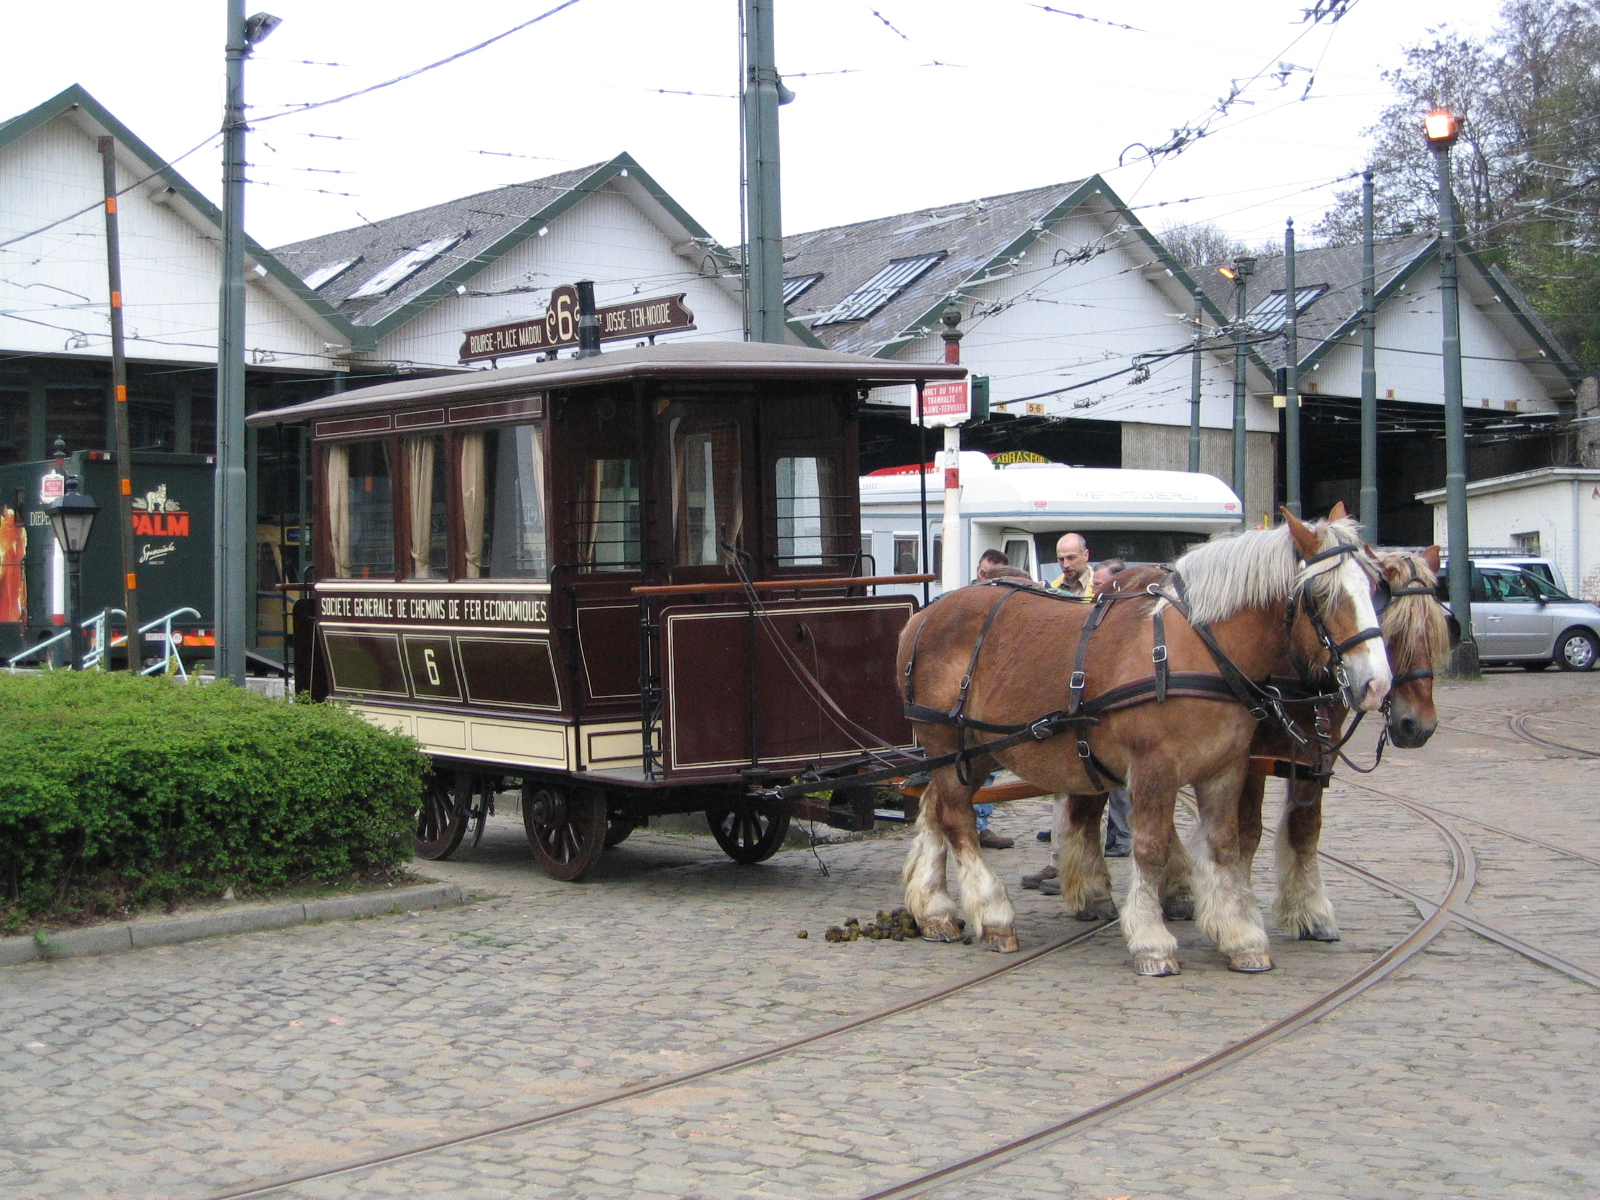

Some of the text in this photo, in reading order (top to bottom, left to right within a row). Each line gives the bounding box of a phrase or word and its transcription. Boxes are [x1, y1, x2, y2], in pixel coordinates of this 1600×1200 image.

[557, 295, 573, 341] 6
[604, 302, 672, 333] JOSSE-TEN-NOODE
[470, 325, 542, 354] BOURSE-PLACE MADOU
[928, 395, 956, 405] TRAMHALTE
[940, 387, 947, 395] DU
[949, 386, 963, 394] TRAM
[923, 404, 966, 415] OLUWE-TERVUREN
[1028, 404, 1041, 412] 5-6
[321, 597, 548, 622] SOCIETE GENERALE DE CHEMINS DE FER ECONOMIQUES
[424, 648, 440, 686] 6
